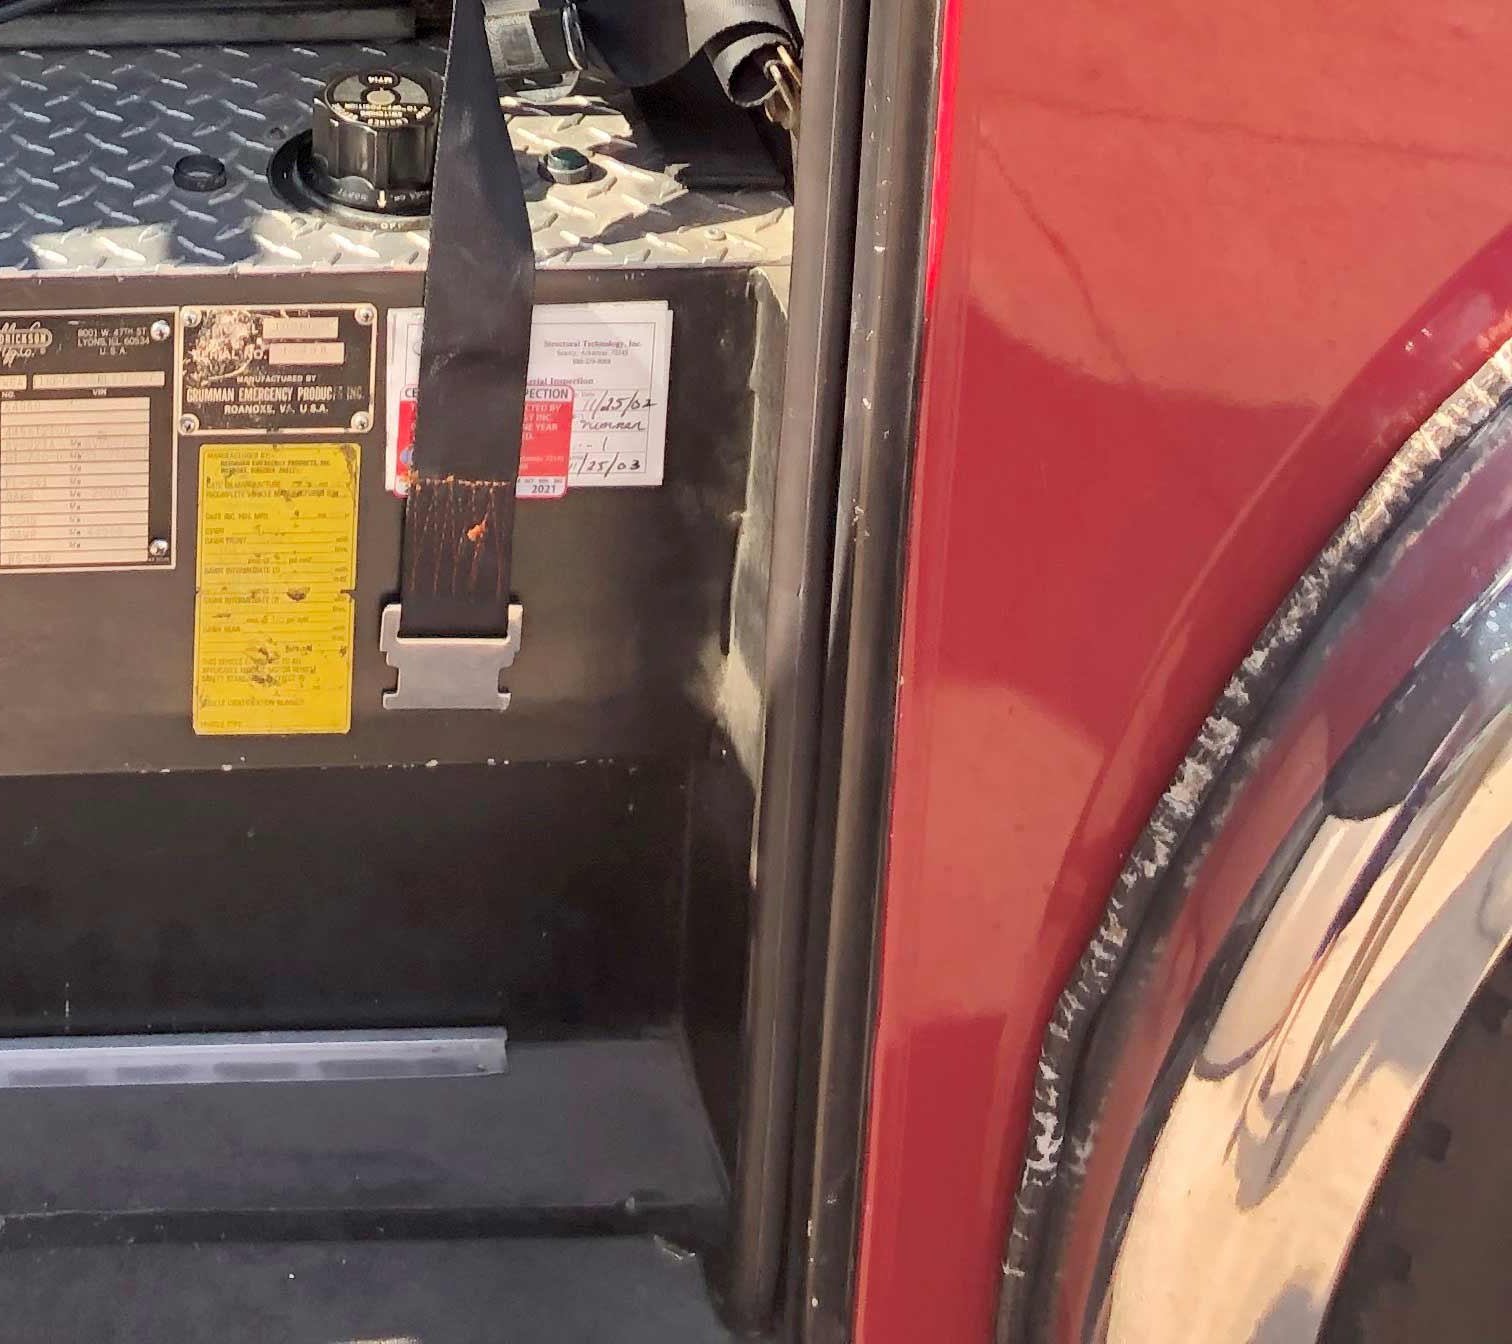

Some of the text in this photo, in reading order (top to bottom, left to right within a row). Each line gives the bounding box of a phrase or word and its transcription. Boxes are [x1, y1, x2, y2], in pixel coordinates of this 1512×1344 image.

[360, 110, 403, 118] SWITCHING
[237, 374, 317, 383] MANUFACTURED BY
[550, 377, 594, 386] Inspection
[92, 388, 107, 396] VIN
[186, 388, 235, 402] GRUMMAN
[238, 387, 294, 402] EMERGENCY
[536, 423, 558, 431] YEAR
[532, 484, 556, 494] 2021
